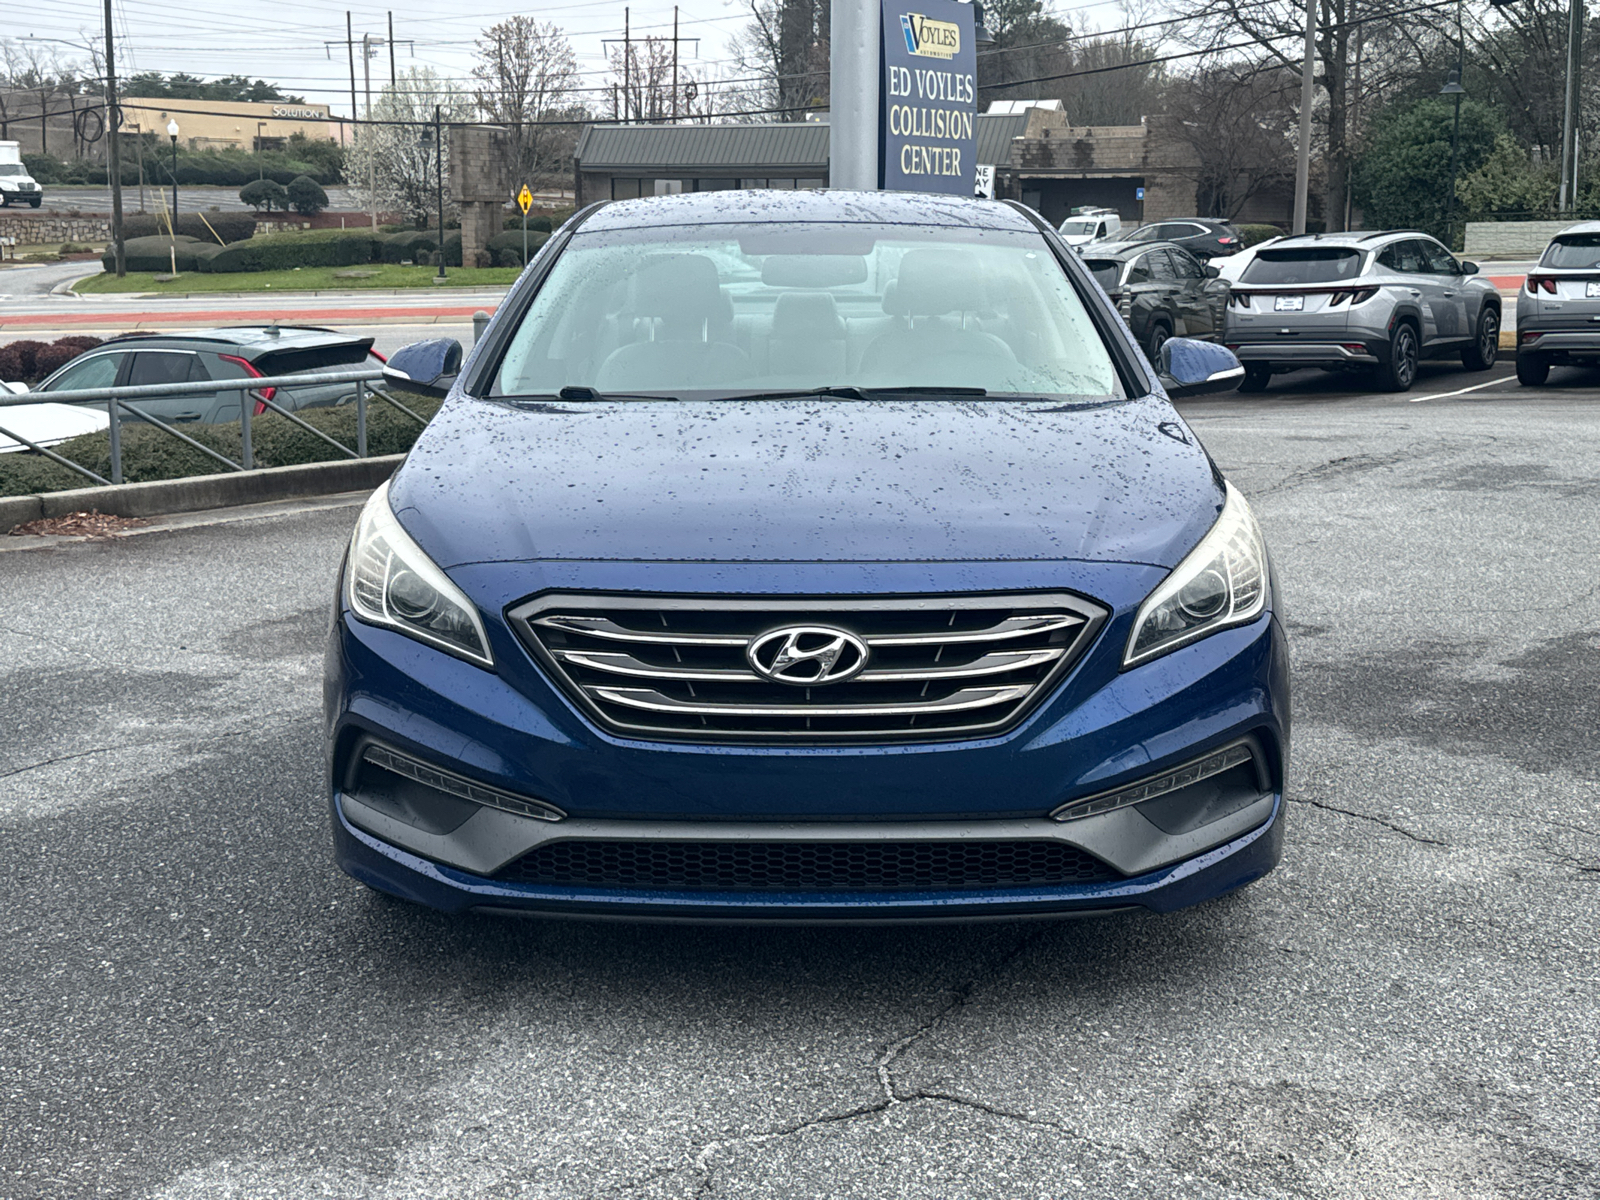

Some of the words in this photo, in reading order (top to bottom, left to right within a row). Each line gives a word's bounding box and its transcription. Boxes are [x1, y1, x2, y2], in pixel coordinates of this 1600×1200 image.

[908, 14, 957, 50] VOYLES
[889, 66, 911, 97] ED
[915, 69, 973, 104] VOYLES
[890, 104, 973, 140] COLLISION
[901, 144, 962, 177] CENTER
[975, 167, 989, 177] NE
[975, 178, 990, 188] AY
